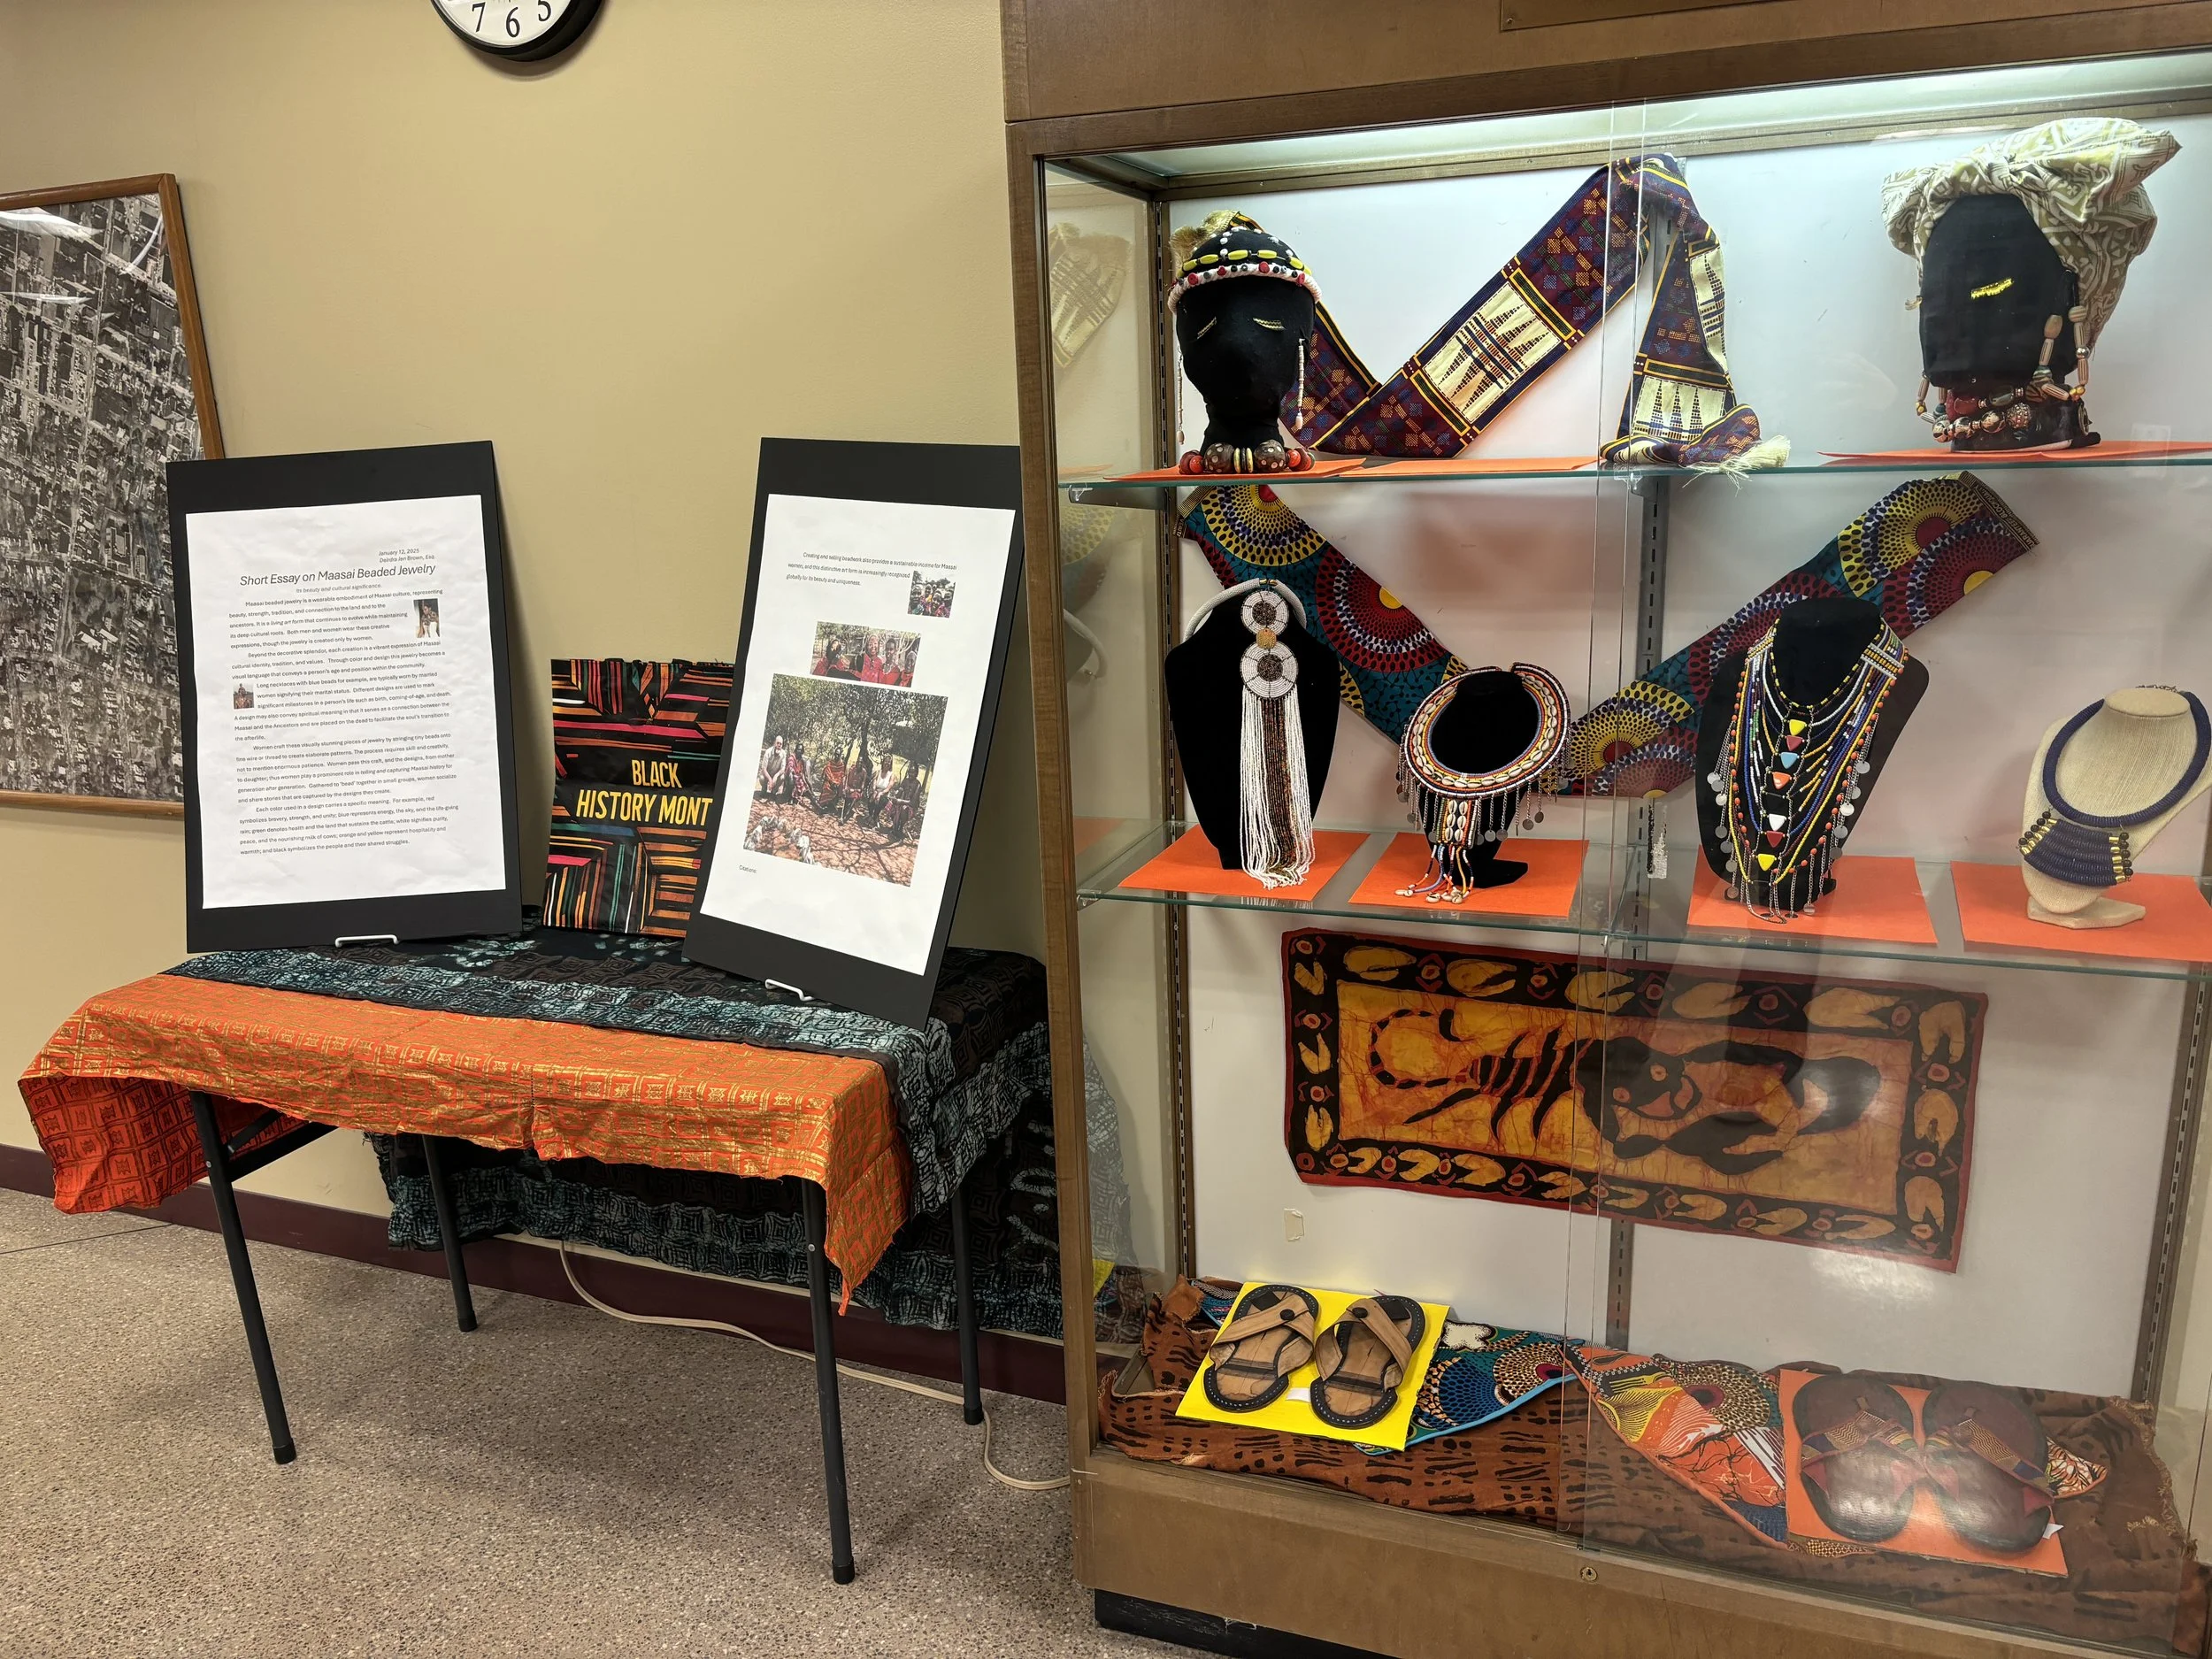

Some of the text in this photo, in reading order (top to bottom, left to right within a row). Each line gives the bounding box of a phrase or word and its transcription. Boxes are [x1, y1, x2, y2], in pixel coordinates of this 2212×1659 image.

[472, 2, 486, 33] 7
[505, 6, 520, 38] 6
[537, 0, 552, 22] 5
[240, 575, 268, 586] Short
[270, 572, 301, 585] Essay
[317, 569, 355, 580] Maasai
[357, 566, 396, 578] Beaded
[397, 564, 435, 576] Jewelry
[631, 759, 682, 788] BLACK
[576, 789, 713, 826] HISTORY MONT
